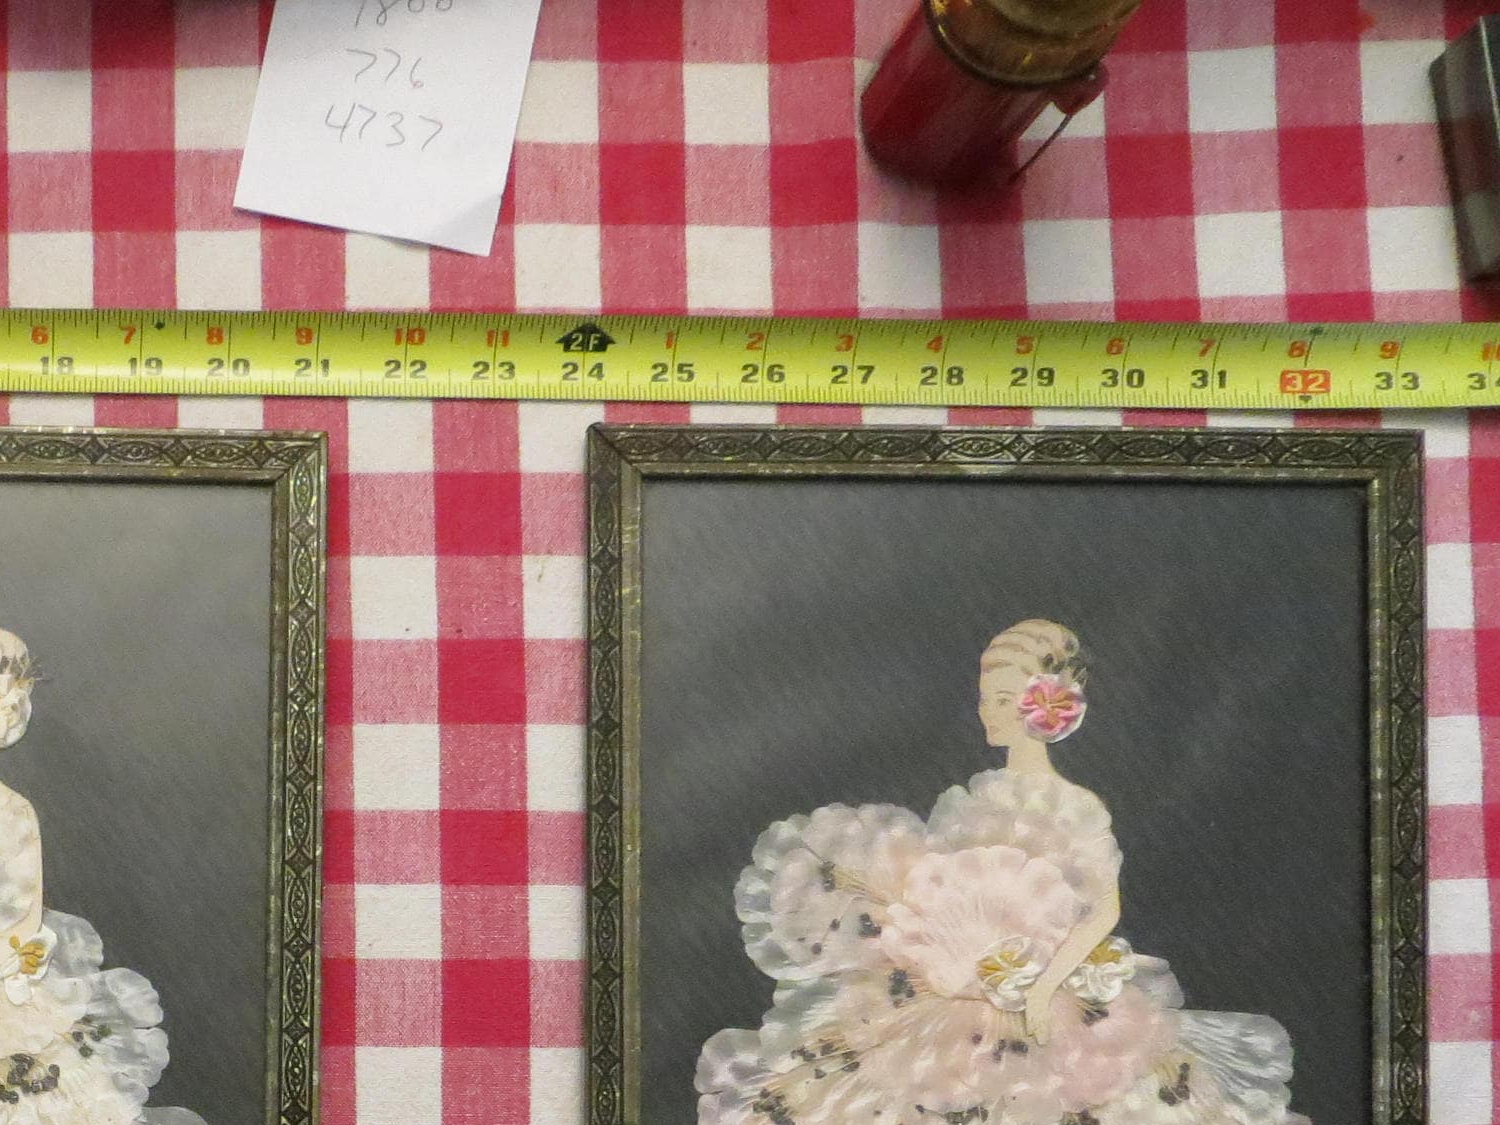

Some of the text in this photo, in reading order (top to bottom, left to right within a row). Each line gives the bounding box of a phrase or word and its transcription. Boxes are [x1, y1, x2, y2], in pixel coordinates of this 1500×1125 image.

[346, 48, 425, 88] 776
[325, 103, 444, 151] 4737
[31, 326, 49, 345] 6
[121, 326, 136, 345] 7
[206, 327, 224, 345] 8
[296, 327, 313, 345] 9
[665, 332, 675, 349] 1
[746, 333, 765, 350] 2
[836, 335, 854, 352] 3
[926, 335, 944, 353] 4
[1016, 336, 1034, 355] 5
[1106, 337, 1124, 355] 6
[1200, 339, 1214, 357] 7
[1288, 341, 1306, 358] 8
[1380, 341, 1399, 359] 9
[570, 333, 600, 351] 2F
[40, 356, 74, 375] 18
[128, 357, 163, 376] 19
[207, 358, 250, 377] 20
[294, 358, 330, 377] 21
[384, 359, 427, 378] 22
[472, 361, 516, 380] 23
[561, 362, 605, 381] 24
[651, 363, 694, 383] 25
[741, 364, 785, 383] 26
[831, 365, 875, 385] 27
[920, 366, 964, 386] 28
[1010, 367, 1055, 387] 29
[1101, 368, 1145, 388] 30
[1191, 369, 1227, 389] 31
[1284, 372, 1327, 392] 32
[1375, 372, 1420, 391] 33
[1467, 372, 1500, 390] 3
